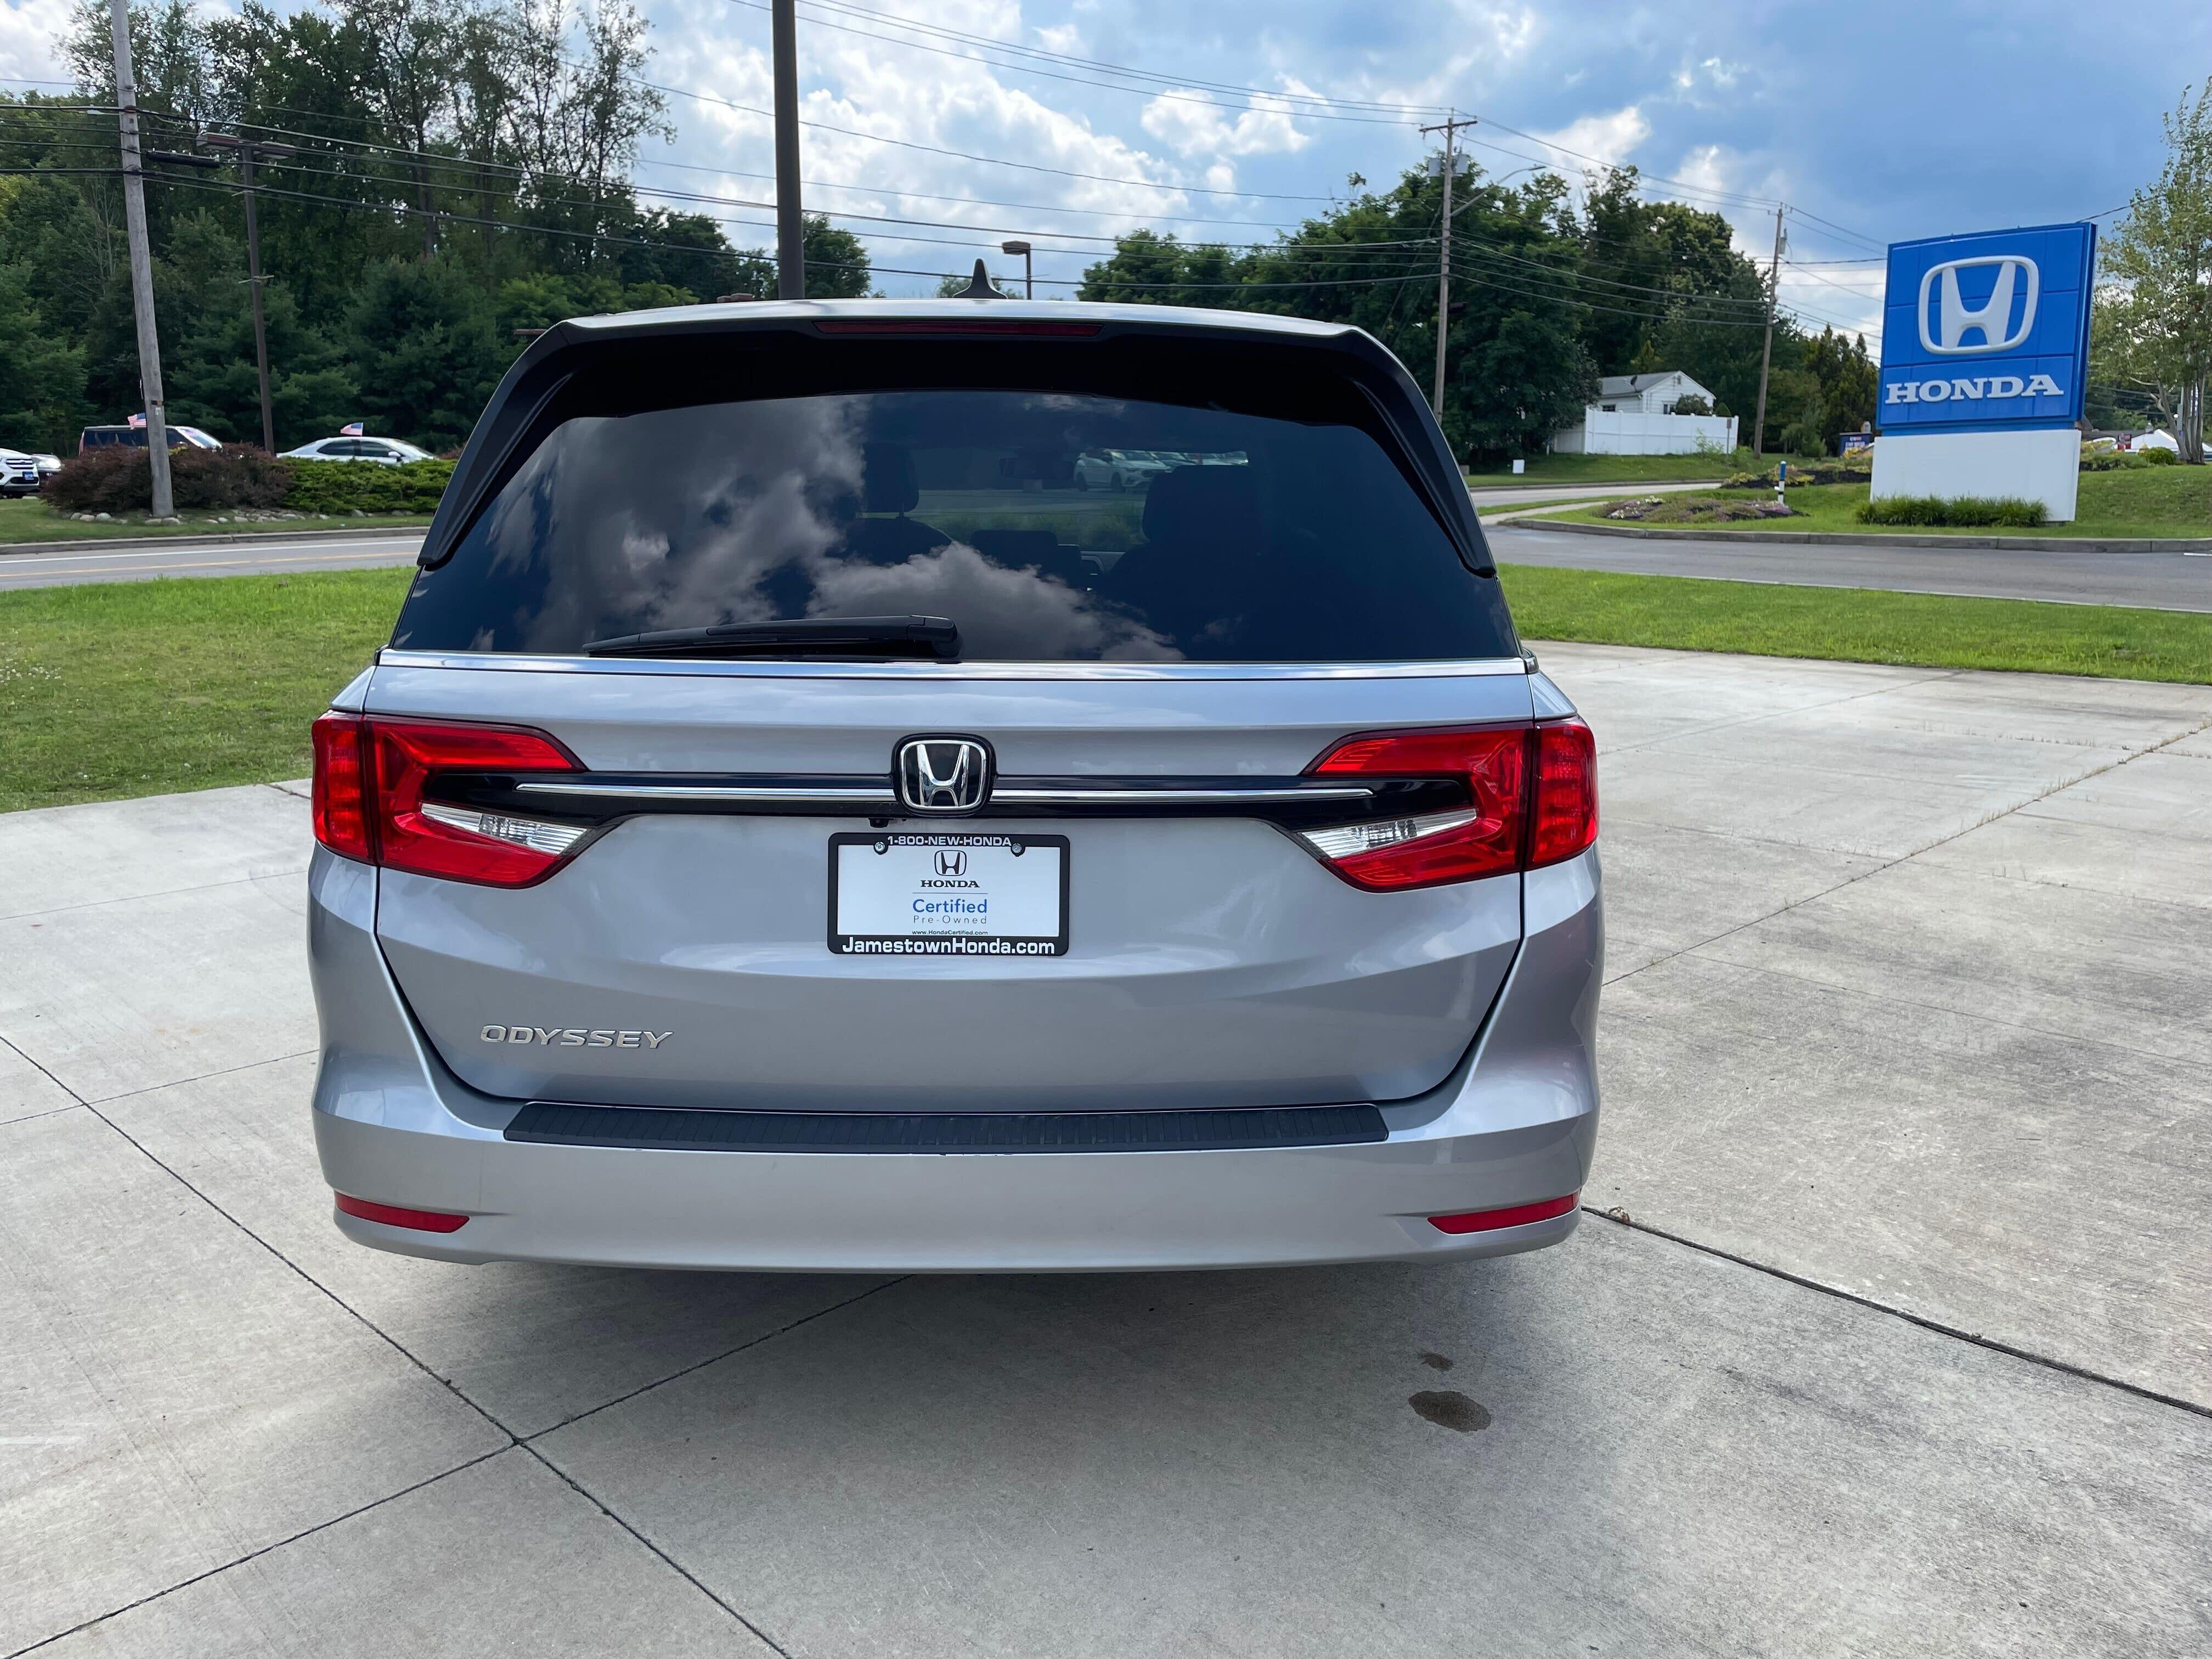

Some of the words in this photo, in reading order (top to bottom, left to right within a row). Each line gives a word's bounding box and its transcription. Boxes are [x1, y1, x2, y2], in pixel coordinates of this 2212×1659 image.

[1885, 374, 2064, 404] HONDA
[888, 836, 1012, 847] 1-800-NEW-HONDA
[912, 899, 988, 913] Certified
[913, 915, 987, 924] Pre-Owned
[842, 936, 1055, 955] JamestownHonda.com
[481, 1024, 673, 1049] ODYSSEY
